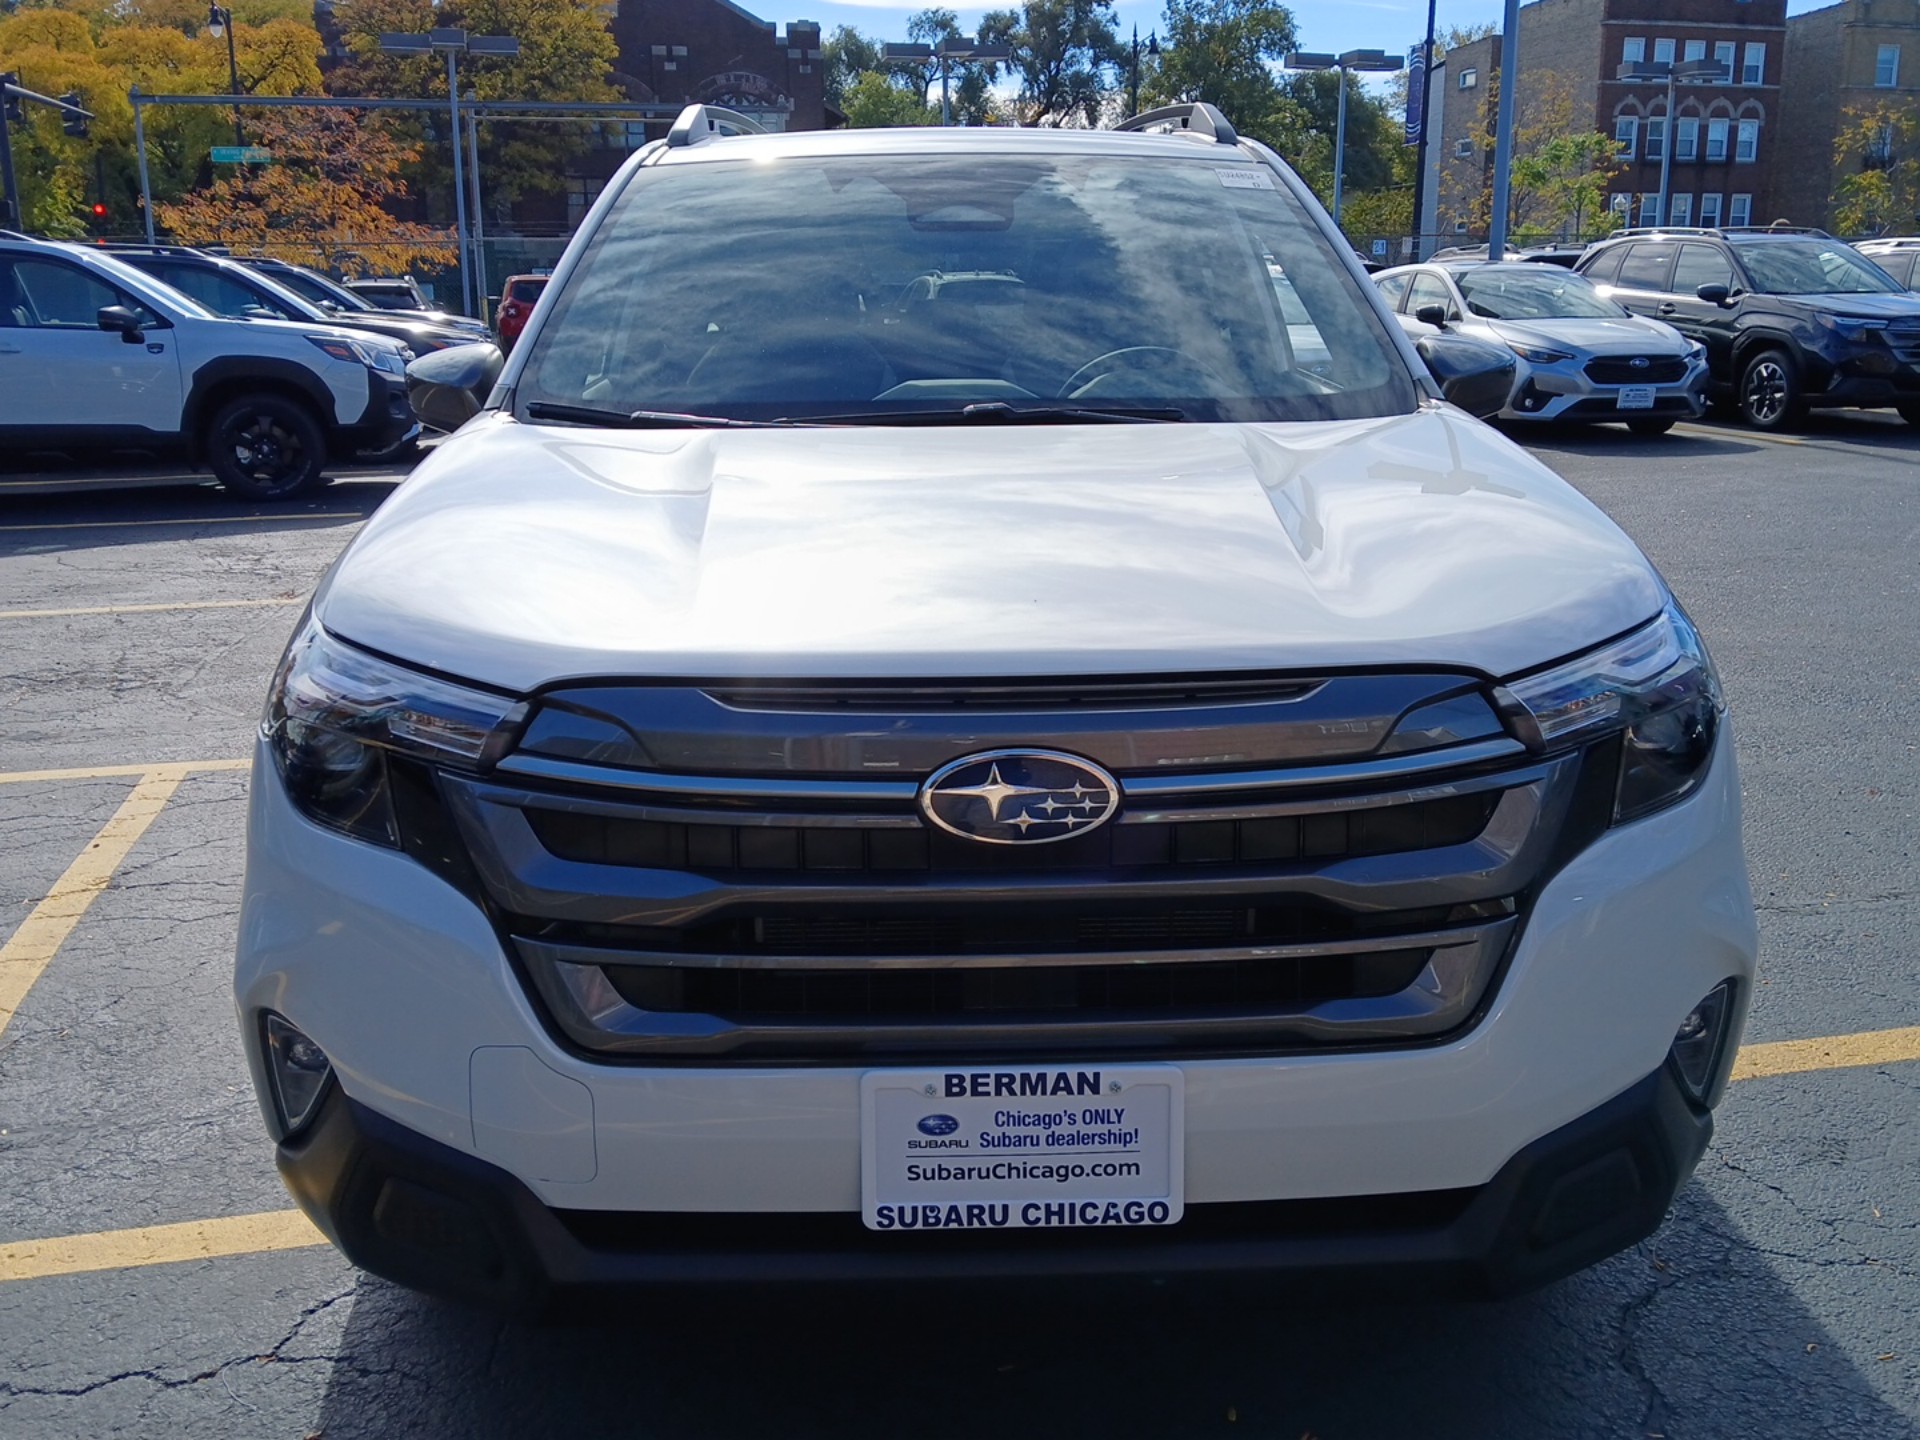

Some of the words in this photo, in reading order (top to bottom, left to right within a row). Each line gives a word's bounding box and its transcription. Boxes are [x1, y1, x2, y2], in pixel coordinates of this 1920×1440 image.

[944, 1071, 1101, 1097] BERMAN
[994, 1109, 1077, 1130] Chicago's
[1082, 1108, 1125, 1126] ONLY
[907, 1139, 969, 1149] SUBARU
[979, 1131, 1040, 1149] Subaru
[1045, 1128, 1139, 1149] dealership!
[907, 1161, 1141, 1183] SubaruChicago.com
[876, 1203, 1009, 1229] SUBARU
[1021, 1200, 1170, 1226] CHICAGO
